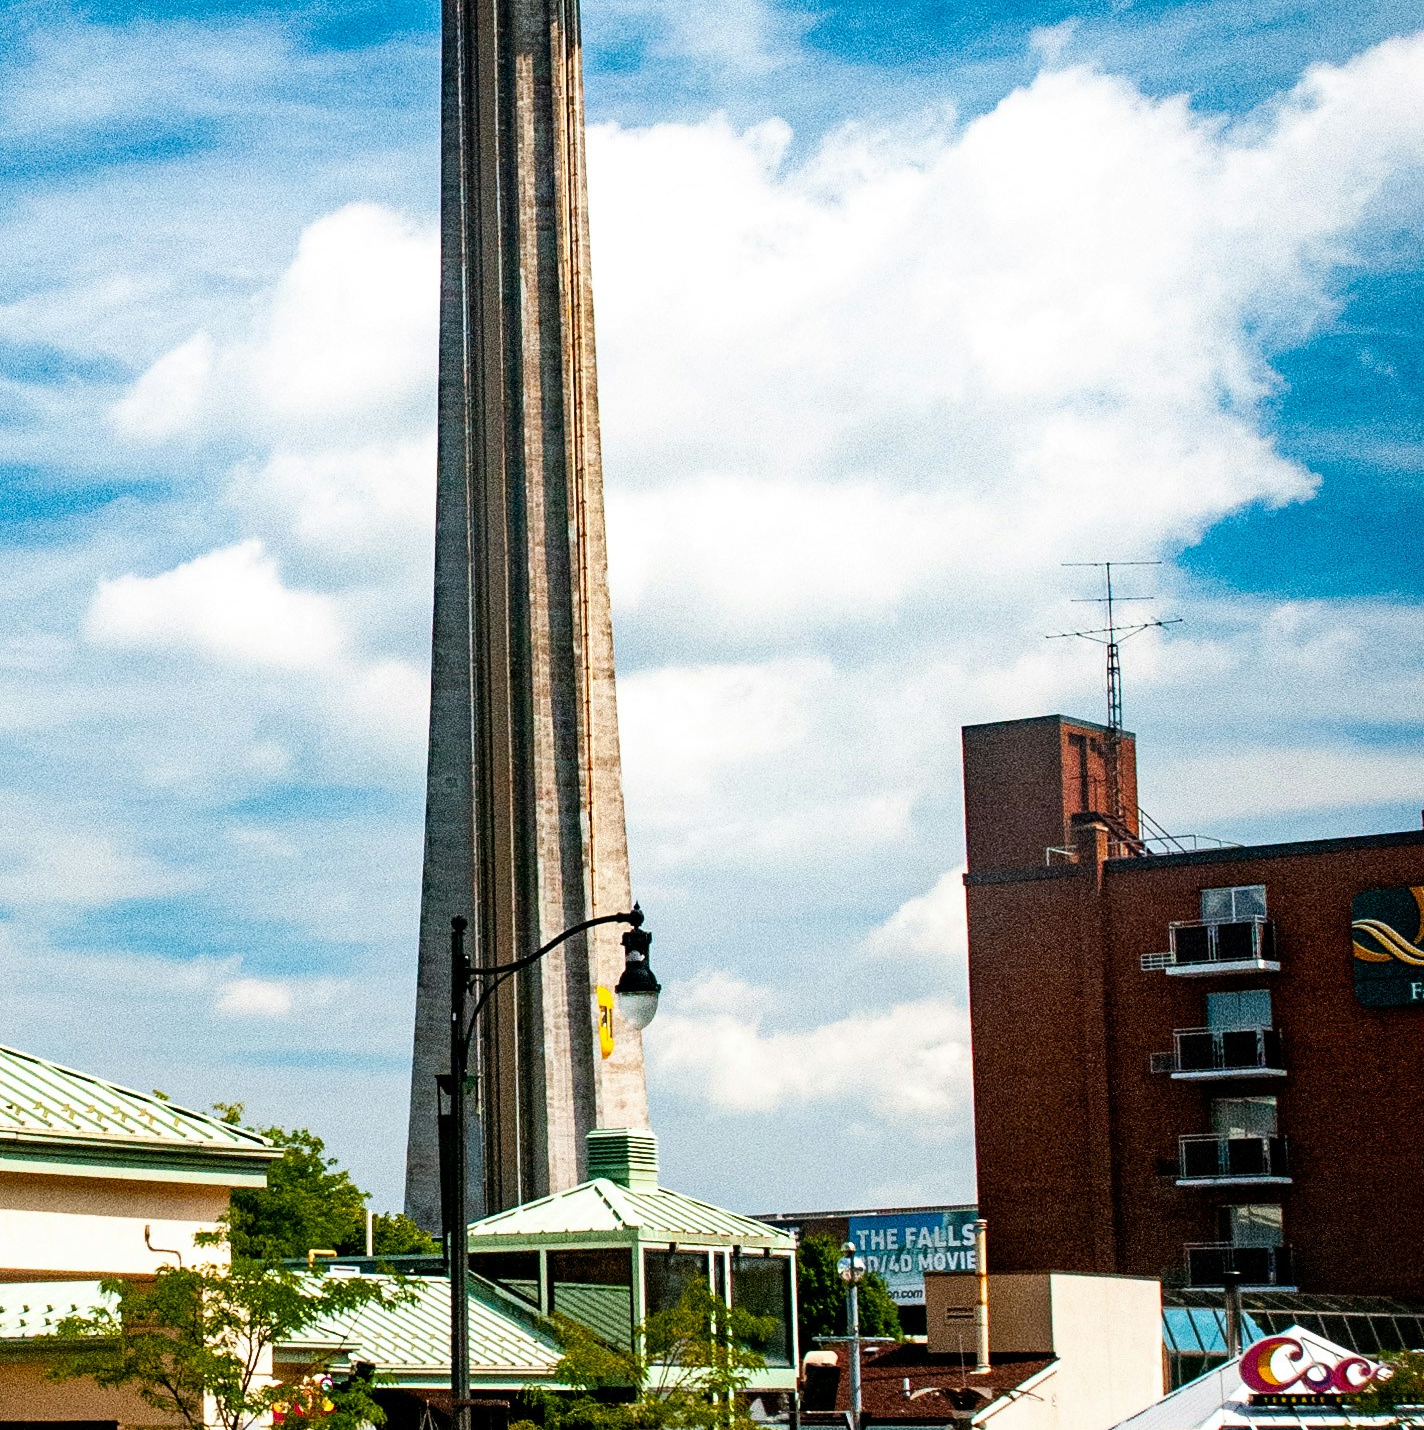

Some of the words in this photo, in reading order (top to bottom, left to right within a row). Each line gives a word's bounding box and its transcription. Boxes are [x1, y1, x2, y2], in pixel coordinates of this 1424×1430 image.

[855, 1226, 900, 1252] THE
[904, 1222, 977, 1251] FALLS
[917, 1249, 977, 1272] MOVIE
